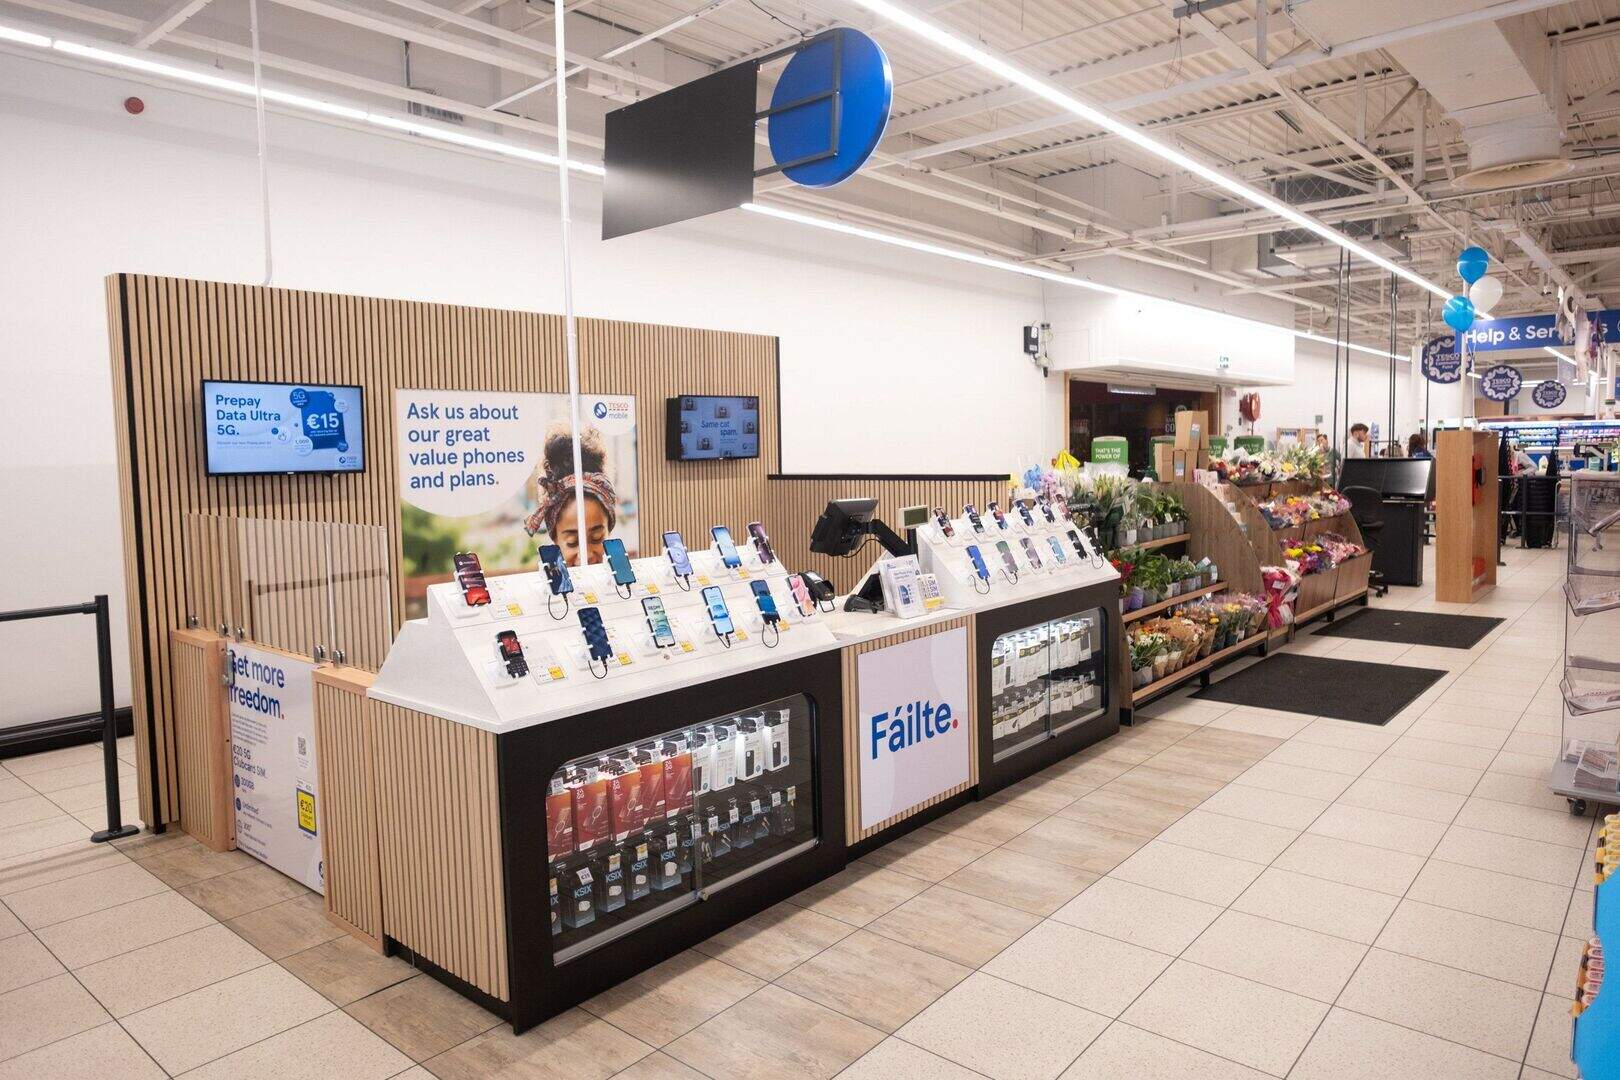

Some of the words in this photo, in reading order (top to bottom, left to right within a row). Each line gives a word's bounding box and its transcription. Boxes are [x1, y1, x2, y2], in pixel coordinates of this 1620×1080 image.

[1465, 329, 1505, 345] Help
[1509, 327, 1521, 341] &
[215, 394, 261, 408] Prepay
[216, 410, 247, 421] Data
[250, 410, 281, 422] Ultra
[407, 402, 440, 420] Ask
[445, 407, 465, 420] us
[469, 404, 519, 420] about
[306, 412, 340, 430] €15
[217, 425, 240, 436] 5G.
[408, 429, 440, 443] our
[445, 427, 490, 447] great
[409, 450, 458, 466] value
[463, 448, 525, 468] phones
[410, 471, 444, 489] and
[450, 470, 500, 492] plans.
[252, 661, 285, 688] more
[229, 683, 285, 720] freedom.
[872, 699, 959, 760] Fáilte.
[660, 849, 676, 862] KSIX
[631, 859, 648, 873] KSIX
[605, 869, 623, 884] KSIX
[574, 884, 593, 899] KSIX
